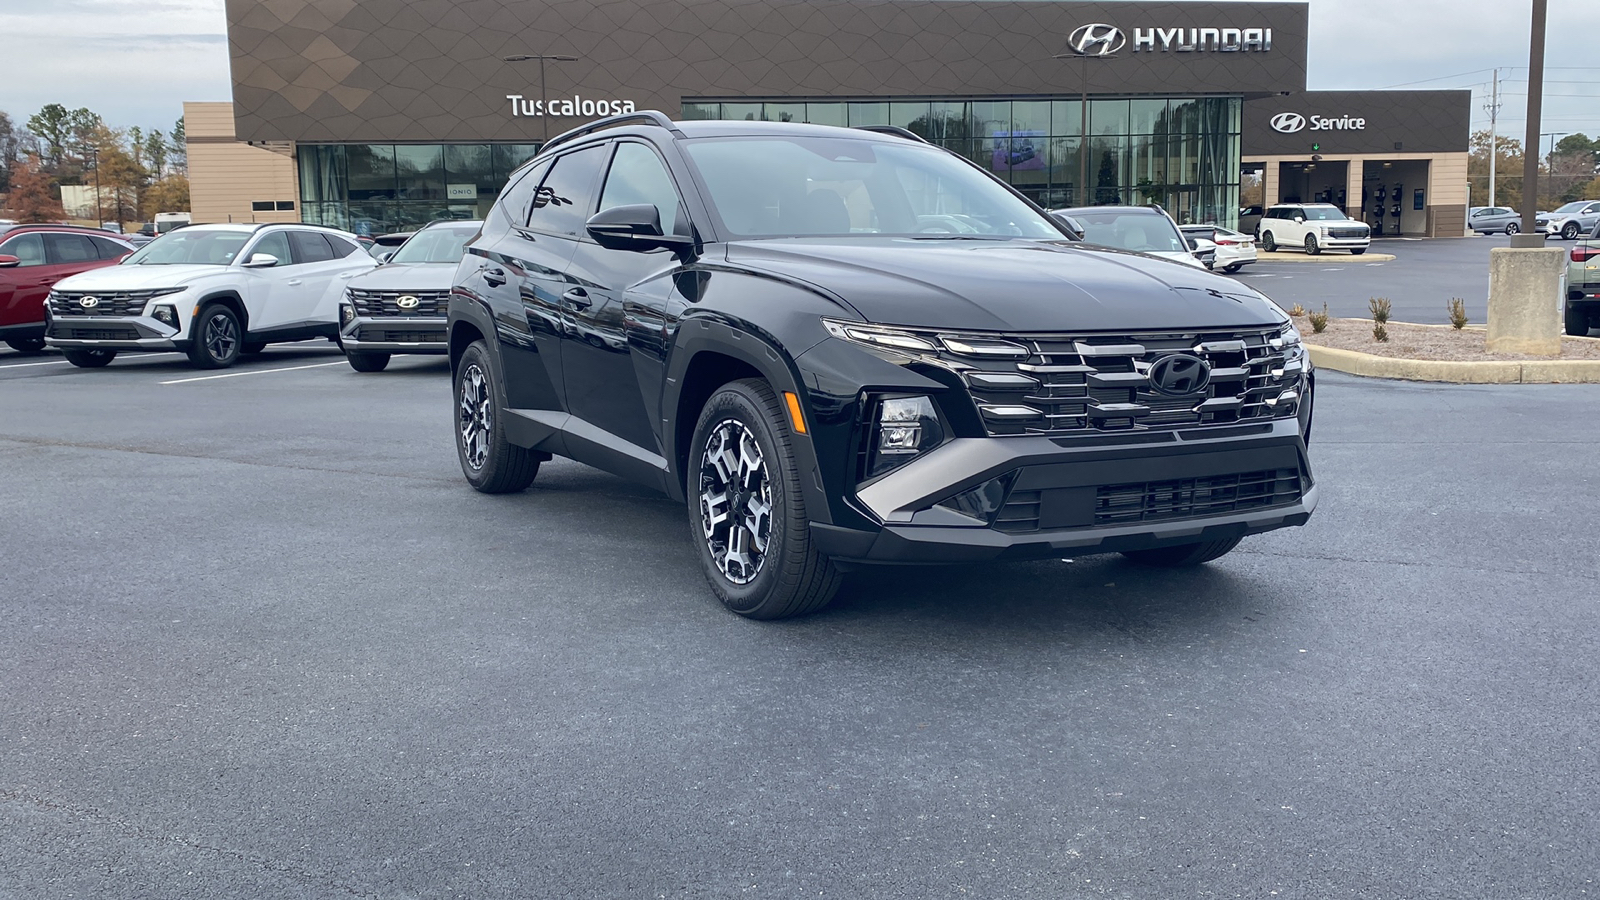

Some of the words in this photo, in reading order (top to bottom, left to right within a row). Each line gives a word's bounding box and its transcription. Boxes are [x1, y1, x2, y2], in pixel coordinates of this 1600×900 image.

[1133, 28, 1272, 51] HYUNDAI
[506, 94, 635, 116] Tuscaloosa
[1309, 114, 1365, 130] Service
